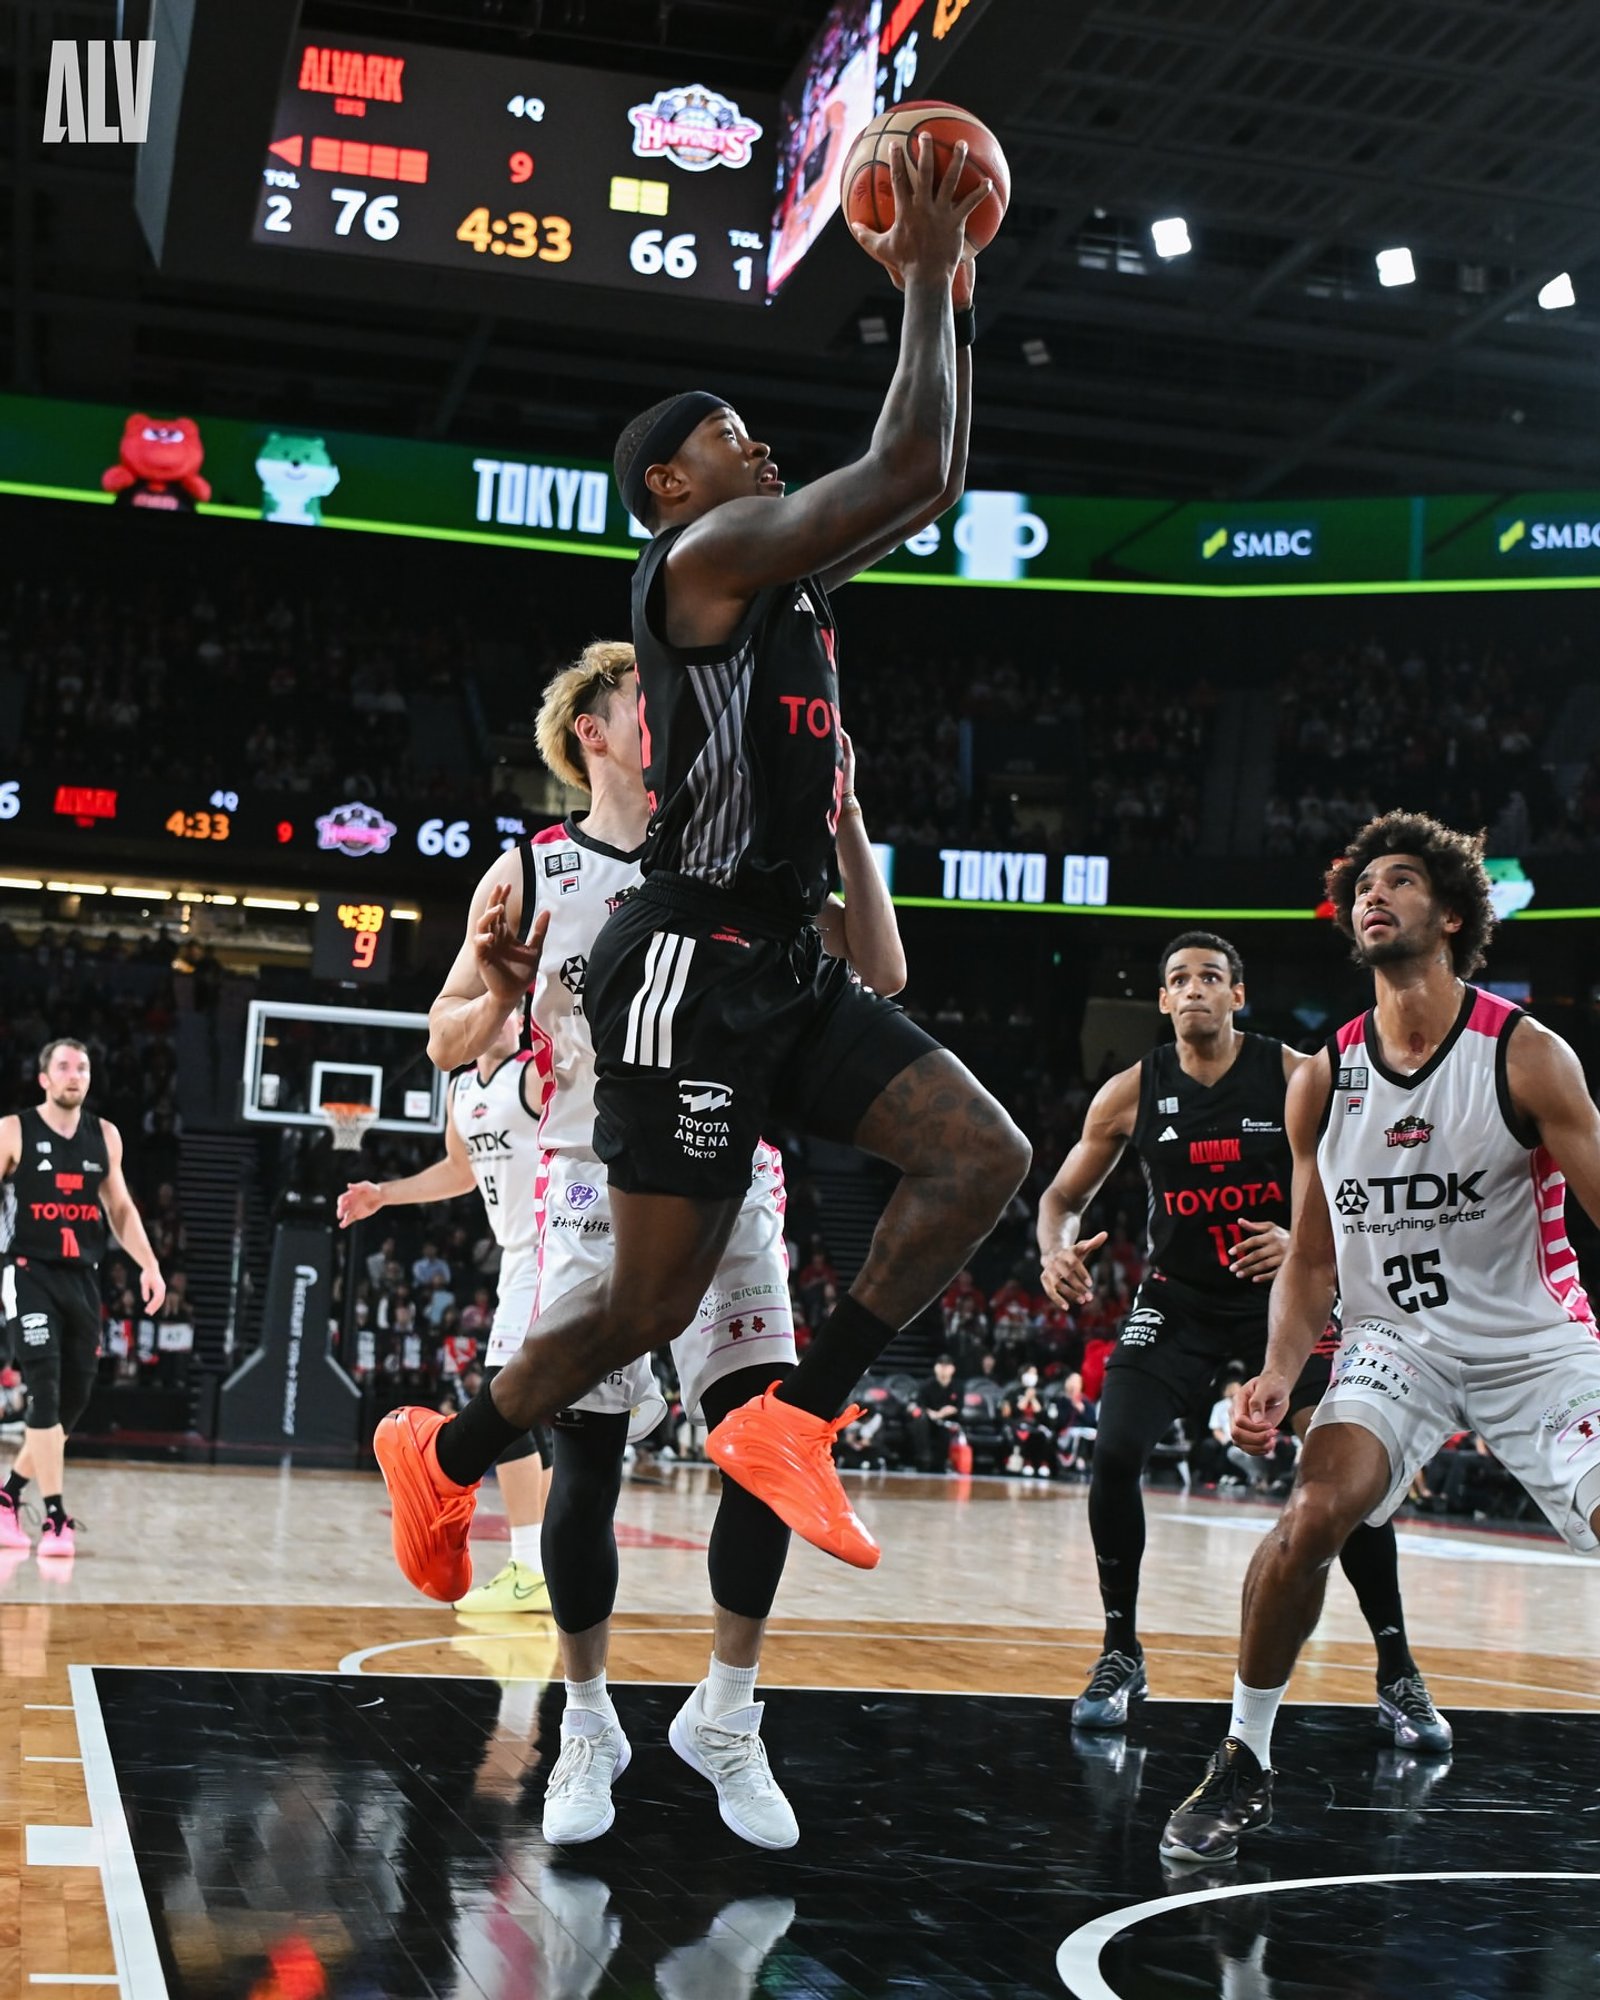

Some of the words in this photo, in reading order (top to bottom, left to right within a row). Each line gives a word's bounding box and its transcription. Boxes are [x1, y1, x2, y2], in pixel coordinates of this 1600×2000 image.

[299, 46, 405, 103] ALVARK
[507, 95, 545, 122] 4Q
[263, 169, 300, 189] TOL
[509, 151, 534, 184] 9
[264, 195, 292, 232] 2
[331, 188, 400, 241] 76
[456, 207, 572, 262] 4:33
[728, 229, 763, 250] TOL
[629, 229, 697, 279] 66
[733, 256, 752, 291] 1
[473, 458, 608, 534] TOKYO
[1232, 529, 1312, 558] SMBC
[210, 790, 239, 812] 4Q
[166, 810, 229, 840] 4:33
[277, 821, 293, 843] 9
[417, 818, 470, 858] 66
[496, 816, 526, 835] TOL
[939, 849, 1046, 903] TOKYO
[1063, 855, 1109, 905] GO
[337, 904, 384, 932] 4:33
[352, 932, 378, 968] 9
[674, 1128, 728, 1146] ARENA
[678, 1114, 730, 1133] TOYOTA
[469, 1130, 512, 1152] TDK
[683, 1145, 717, 1159] TOKYO
[1190, 1138, 1241, 1164] ALVARK
[1164, 1182, 1284, 1215] TOYOTA
[1367, 1169, 1488, 1214] TDK
[1343, 1223, 1355, 1235] In
[1439, 1209, 1487, 1225] Better
[1383, 1248, 1449, 1314] 25
[1120, 1333, 1155, 1343] ARENA
[1125, 1326, 1157, 1336] TOYOTA
